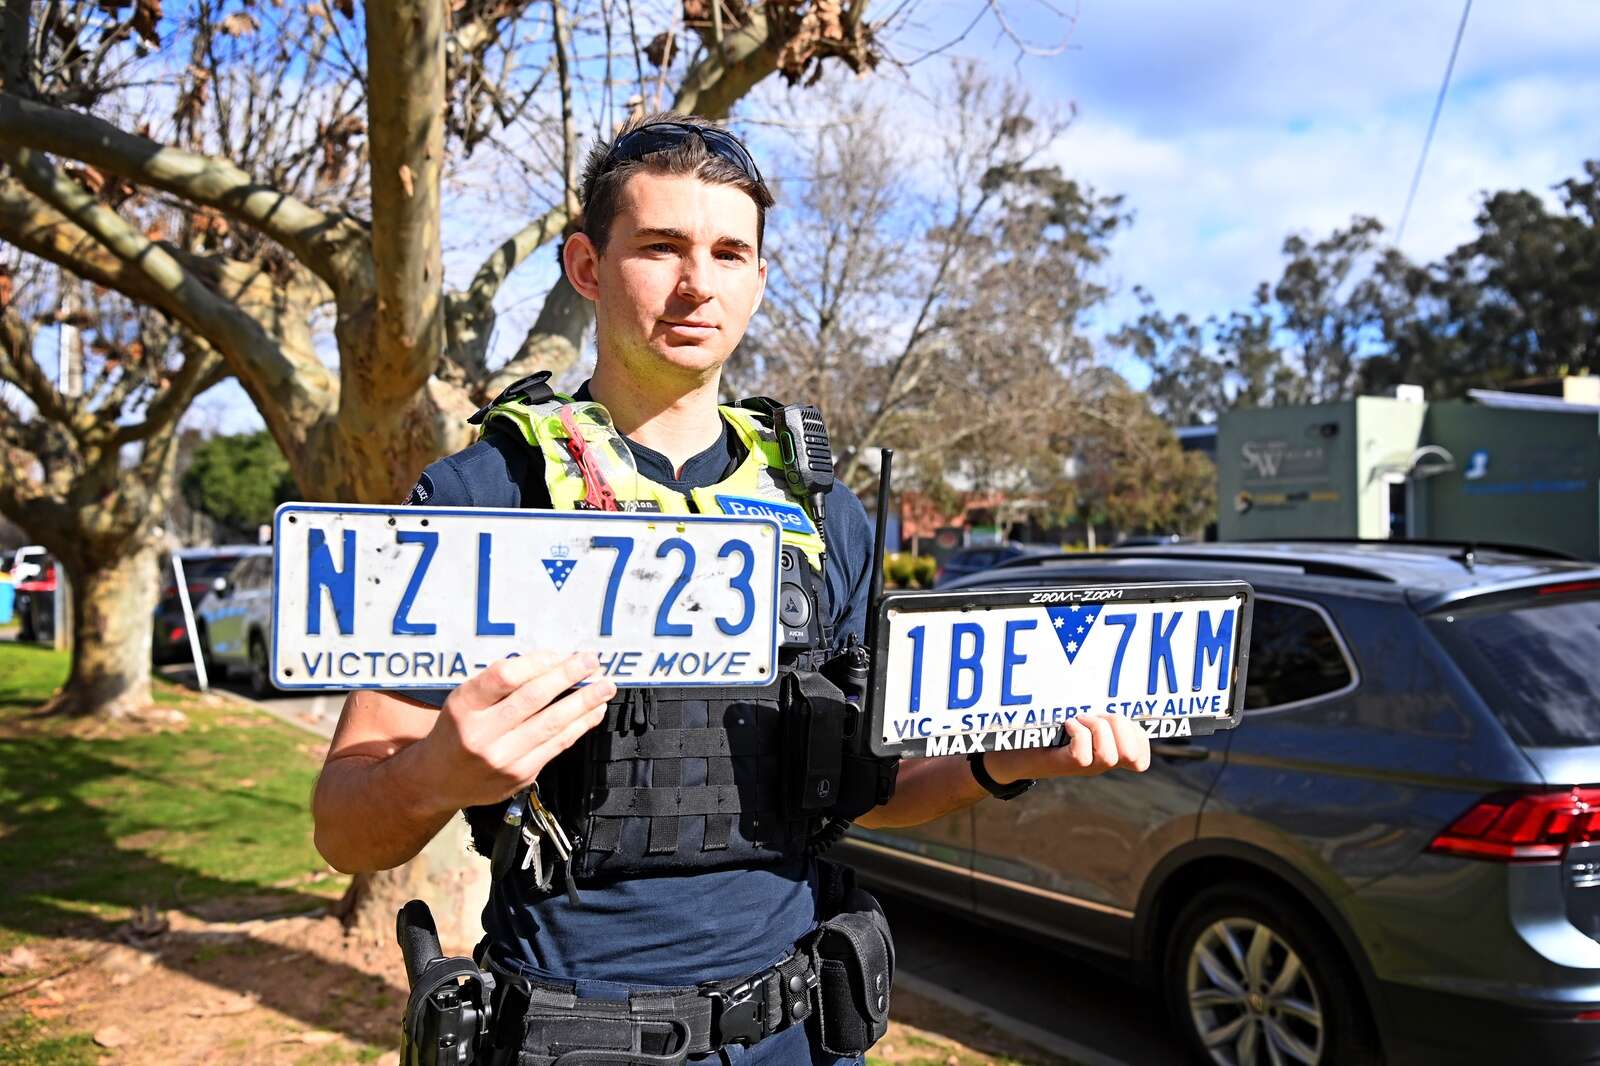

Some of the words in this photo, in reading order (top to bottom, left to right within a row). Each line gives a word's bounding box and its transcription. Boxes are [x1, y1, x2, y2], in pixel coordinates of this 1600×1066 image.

[728, 502, 801, 525] Police
[306, 528, 515, 635] NZL
[590, 536, 756, 636] 723
[1029, 589, 1124, 604] ZOOM-ZOOM
[597, 652, 642, 676] HE
[649, 652, 751, 677] MOVE
[907, 619, 1038, 713] 1BE
[1104, 609, 1235, 698] 7KM
[893, 717, 933, 738] VIC
[961, 710, 1018, 732] STAY
[1163, 695, 1221, 717] ALIVE
[925, 732, 986, 757] MAX
[994, 725, 1065, 751] KIRW
[1143, 718, 1192, 739] ZDA
